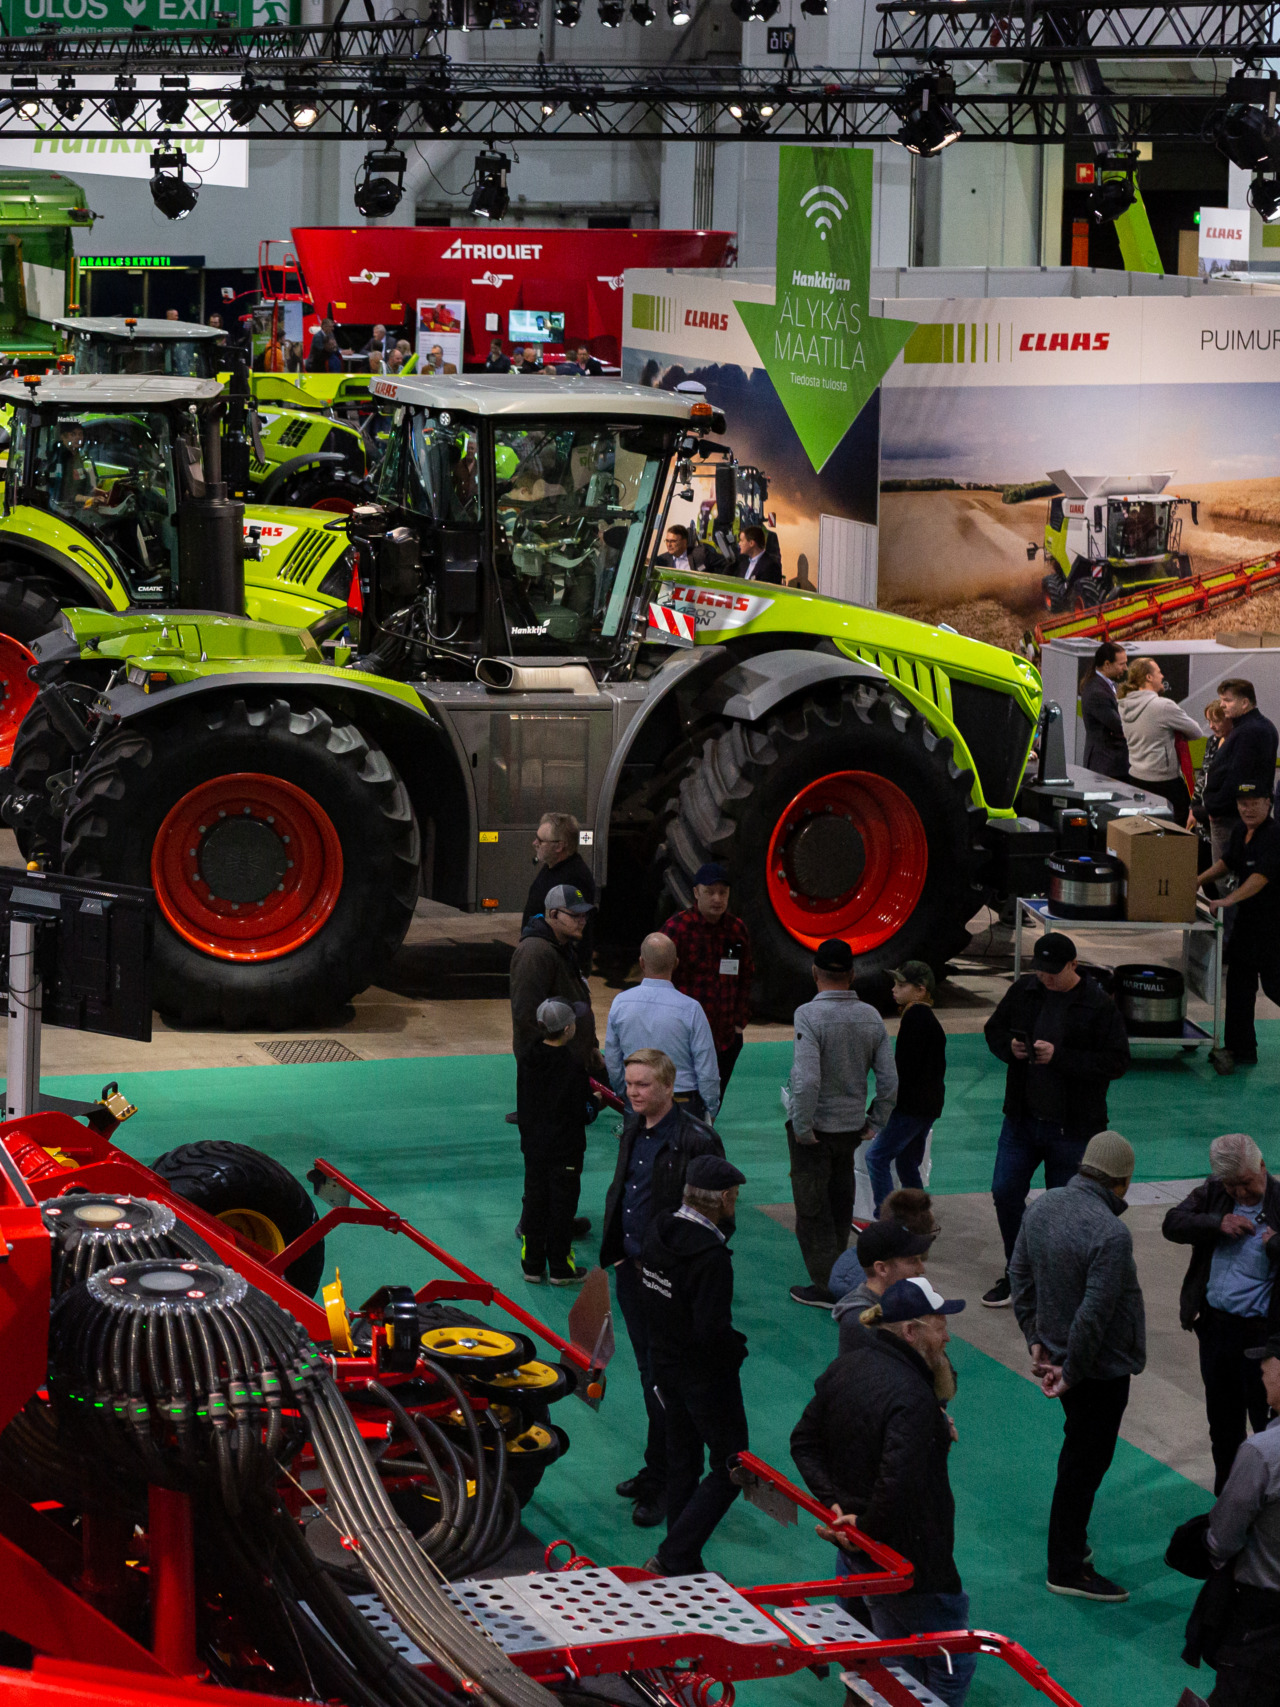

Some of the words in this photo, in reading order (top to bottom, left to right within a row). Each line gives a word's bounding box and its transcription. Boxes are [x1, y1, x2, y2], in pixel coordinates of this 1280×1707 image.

[1205, 226, 1243, 241] CLAAS
[461, 244, 543, 260] TRIOLIET
[791, 269, 851, 295] Hankkijan
[684, 308, 729, 332] CLAAS
[780, 291, 861, 335] ÄLYKÄS
[774, 330, 867, 373] MAATILA
[1019, 332, 1110, 352] CLAAS
[790, 371, 821, 388] Tiedosta
[822, 377, 848, 392] tulosta
[671, 586, 750, 612] CLAAS
[511, 625, 547, 636] Hankkija
[1122, 979, 1166, 992] HARTWALL
